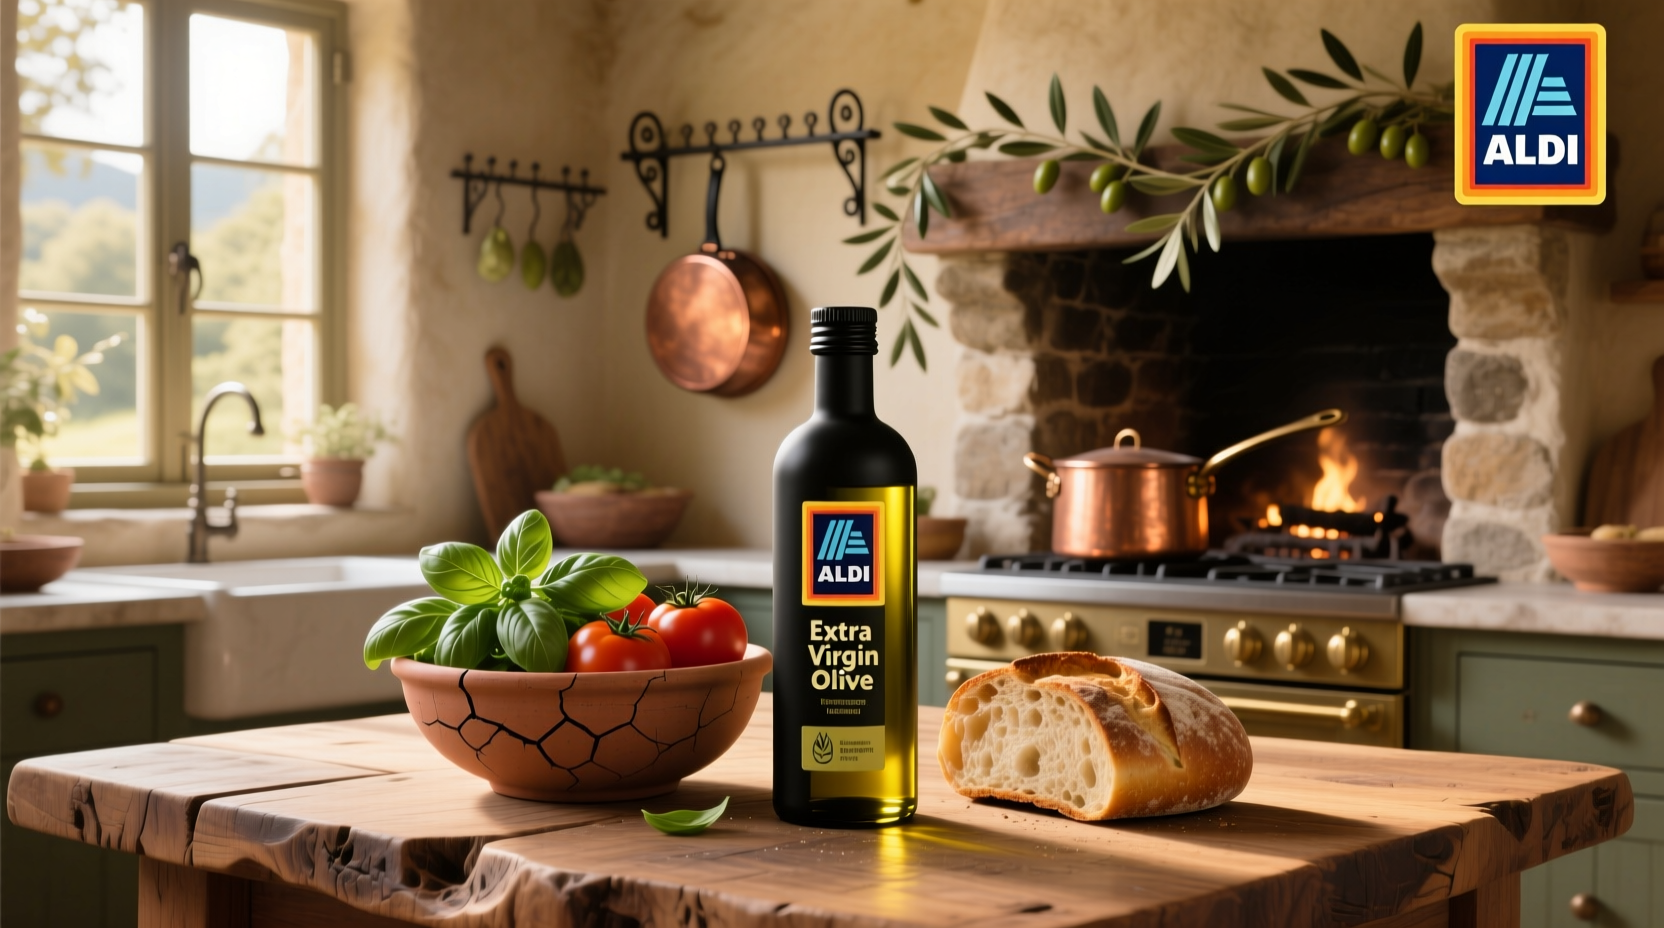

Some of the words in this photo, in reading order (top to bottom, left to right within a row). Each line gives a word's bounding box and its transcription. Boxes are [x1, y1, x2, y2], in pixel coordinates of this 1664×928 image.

[817, 565, 870, 583] ALDI
[810, 619, 872, 642] Extra
[807, 644, 879, 671] Virgin
[811, 669, 874, 691] Olive
